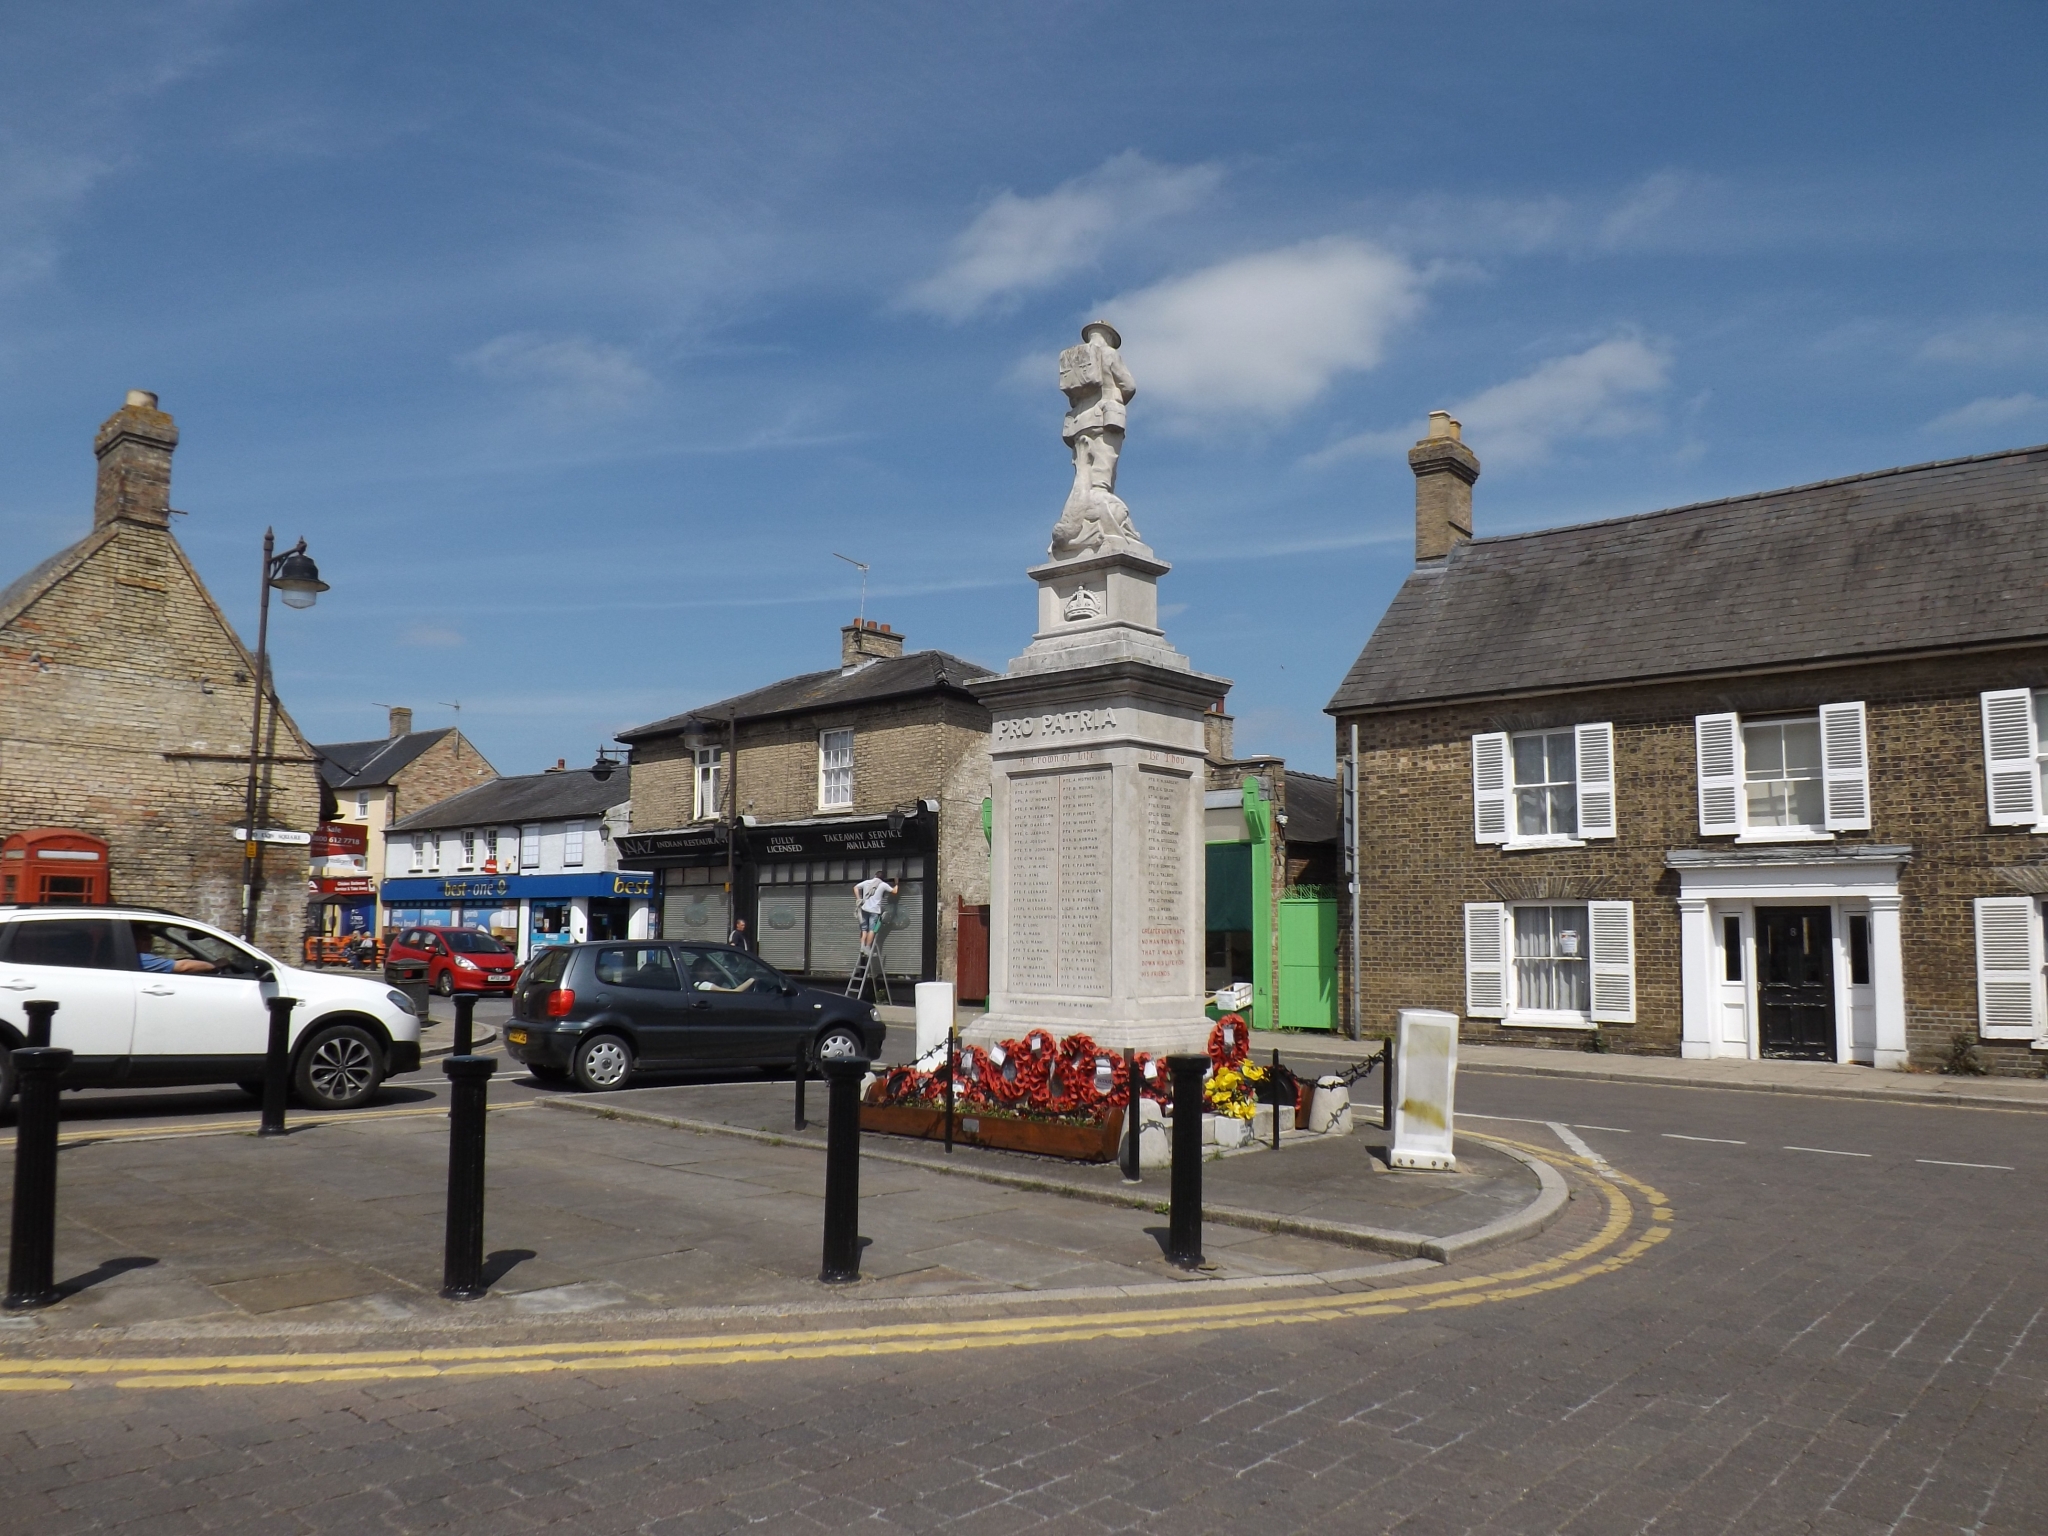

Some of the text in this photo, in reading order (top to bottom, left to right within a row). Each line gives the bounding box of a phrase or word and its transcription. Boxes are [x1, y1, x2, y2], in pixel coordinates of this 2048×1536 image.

[998, 707, 1117, 741] PRO PATRIA
[1030, 755, 1059, 764] Crown
[1062, 753, 1071, 762] of
[1077, 751, 1095, 761] Life
[1149, 751, 1185, 764] Be Thou
[326, 825, 342, 833] Sale
[343, 837, 360, 845] 7718
[770, 836, 795, 845] FULLY
[823, 832, 864, 843] TAKEAWAY
[620, 836, 655, 855] NAZ
[656, 840, 683, 848] INDIAN
[766, 844, 803, 853] LICENSED
[846, 840, 886, 850] AVAILABLE
[613, 877, 651, 895] best
[1790, 927, 1797, 937] 8
